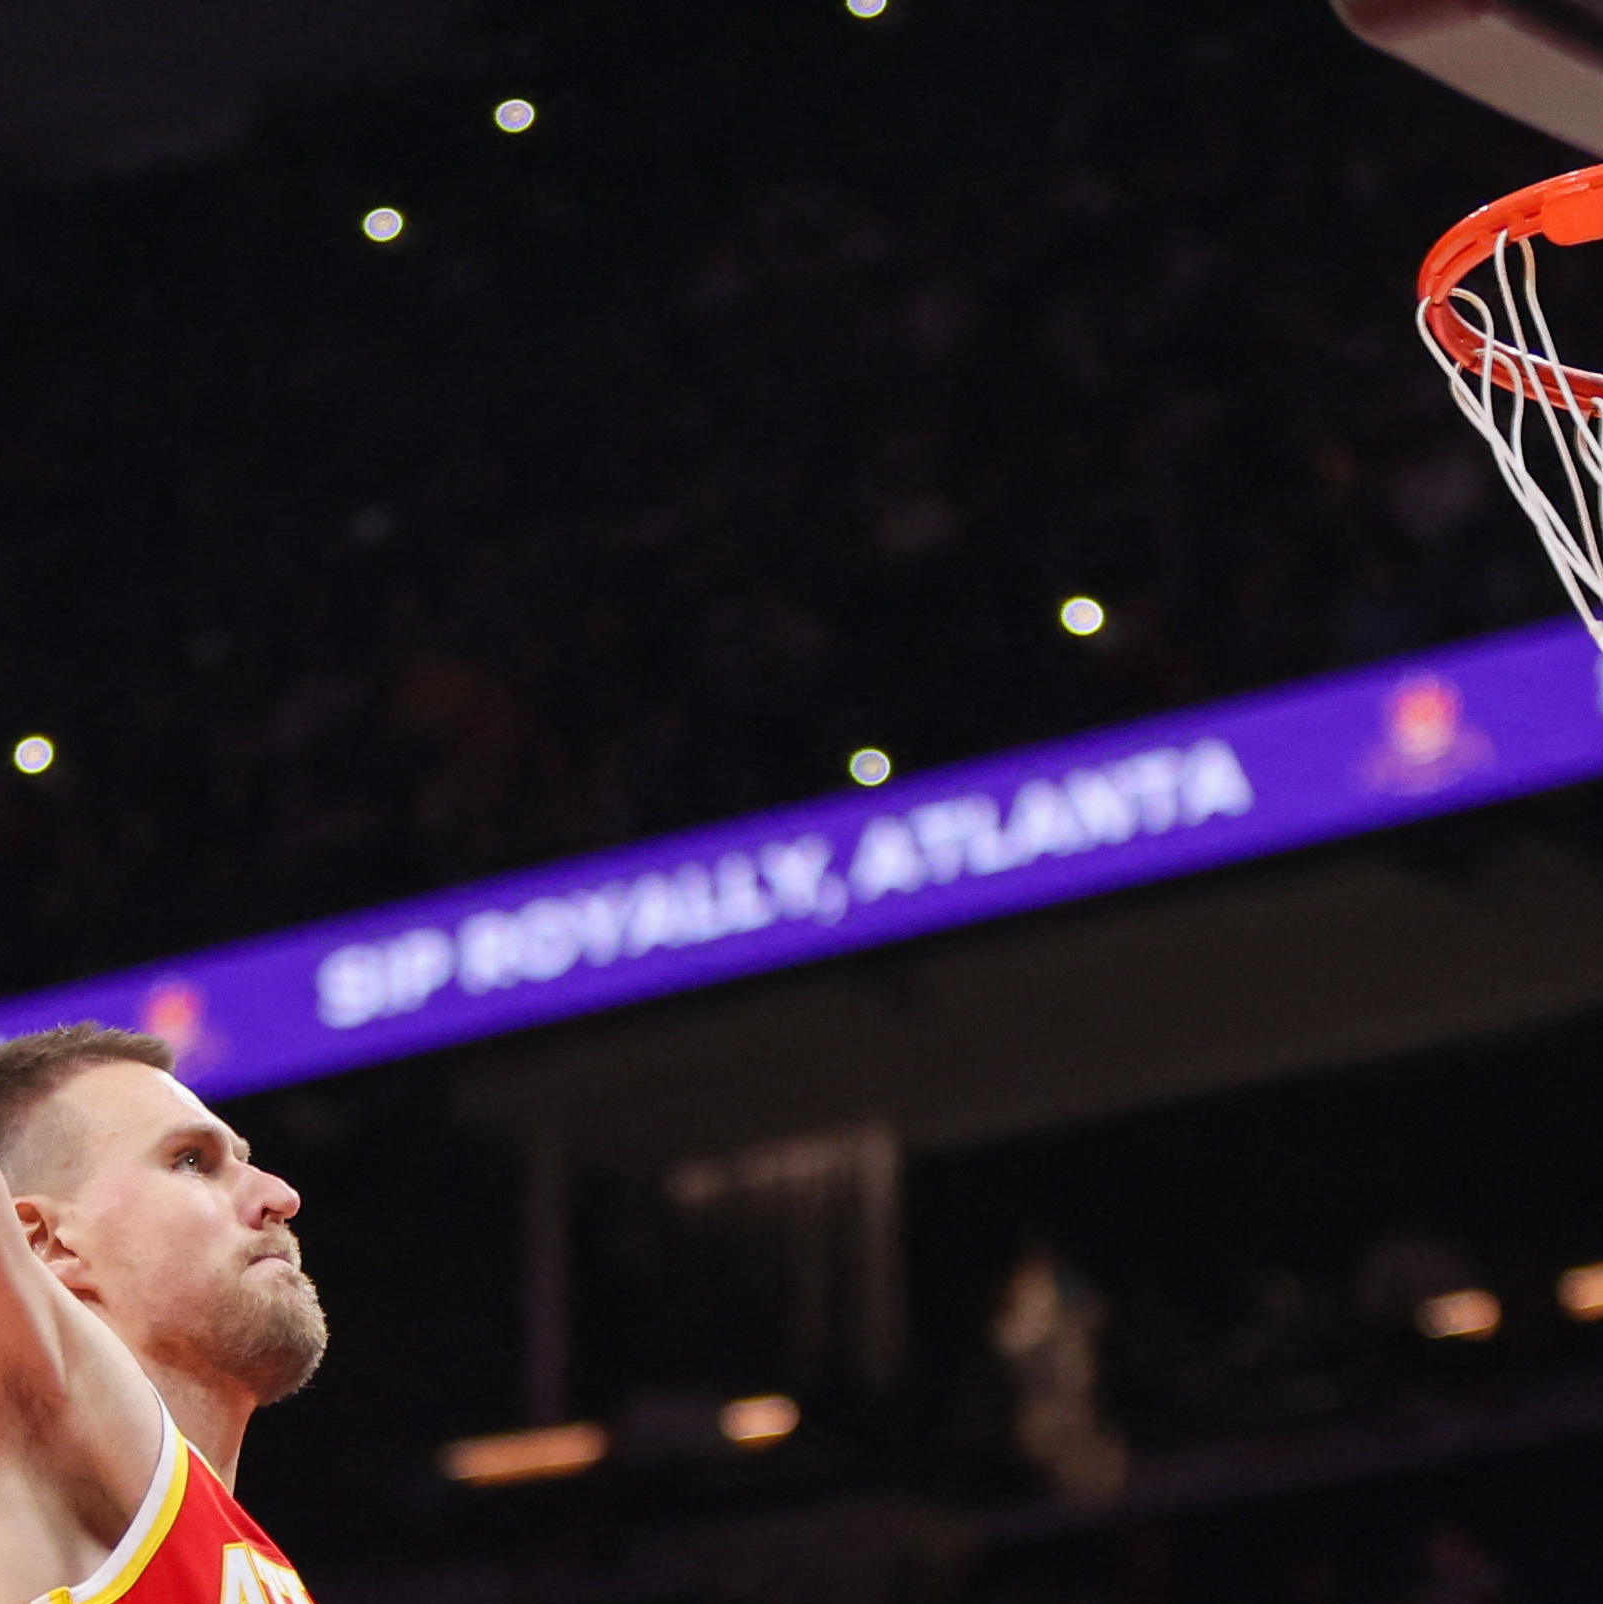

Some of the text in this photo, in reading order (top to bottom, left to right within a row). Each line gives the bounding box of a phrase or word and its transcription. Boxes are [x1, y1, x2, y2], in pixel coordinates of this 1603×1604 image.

[317, 739, 1253, 1029] SIP ROYALLY, ATLANTA
